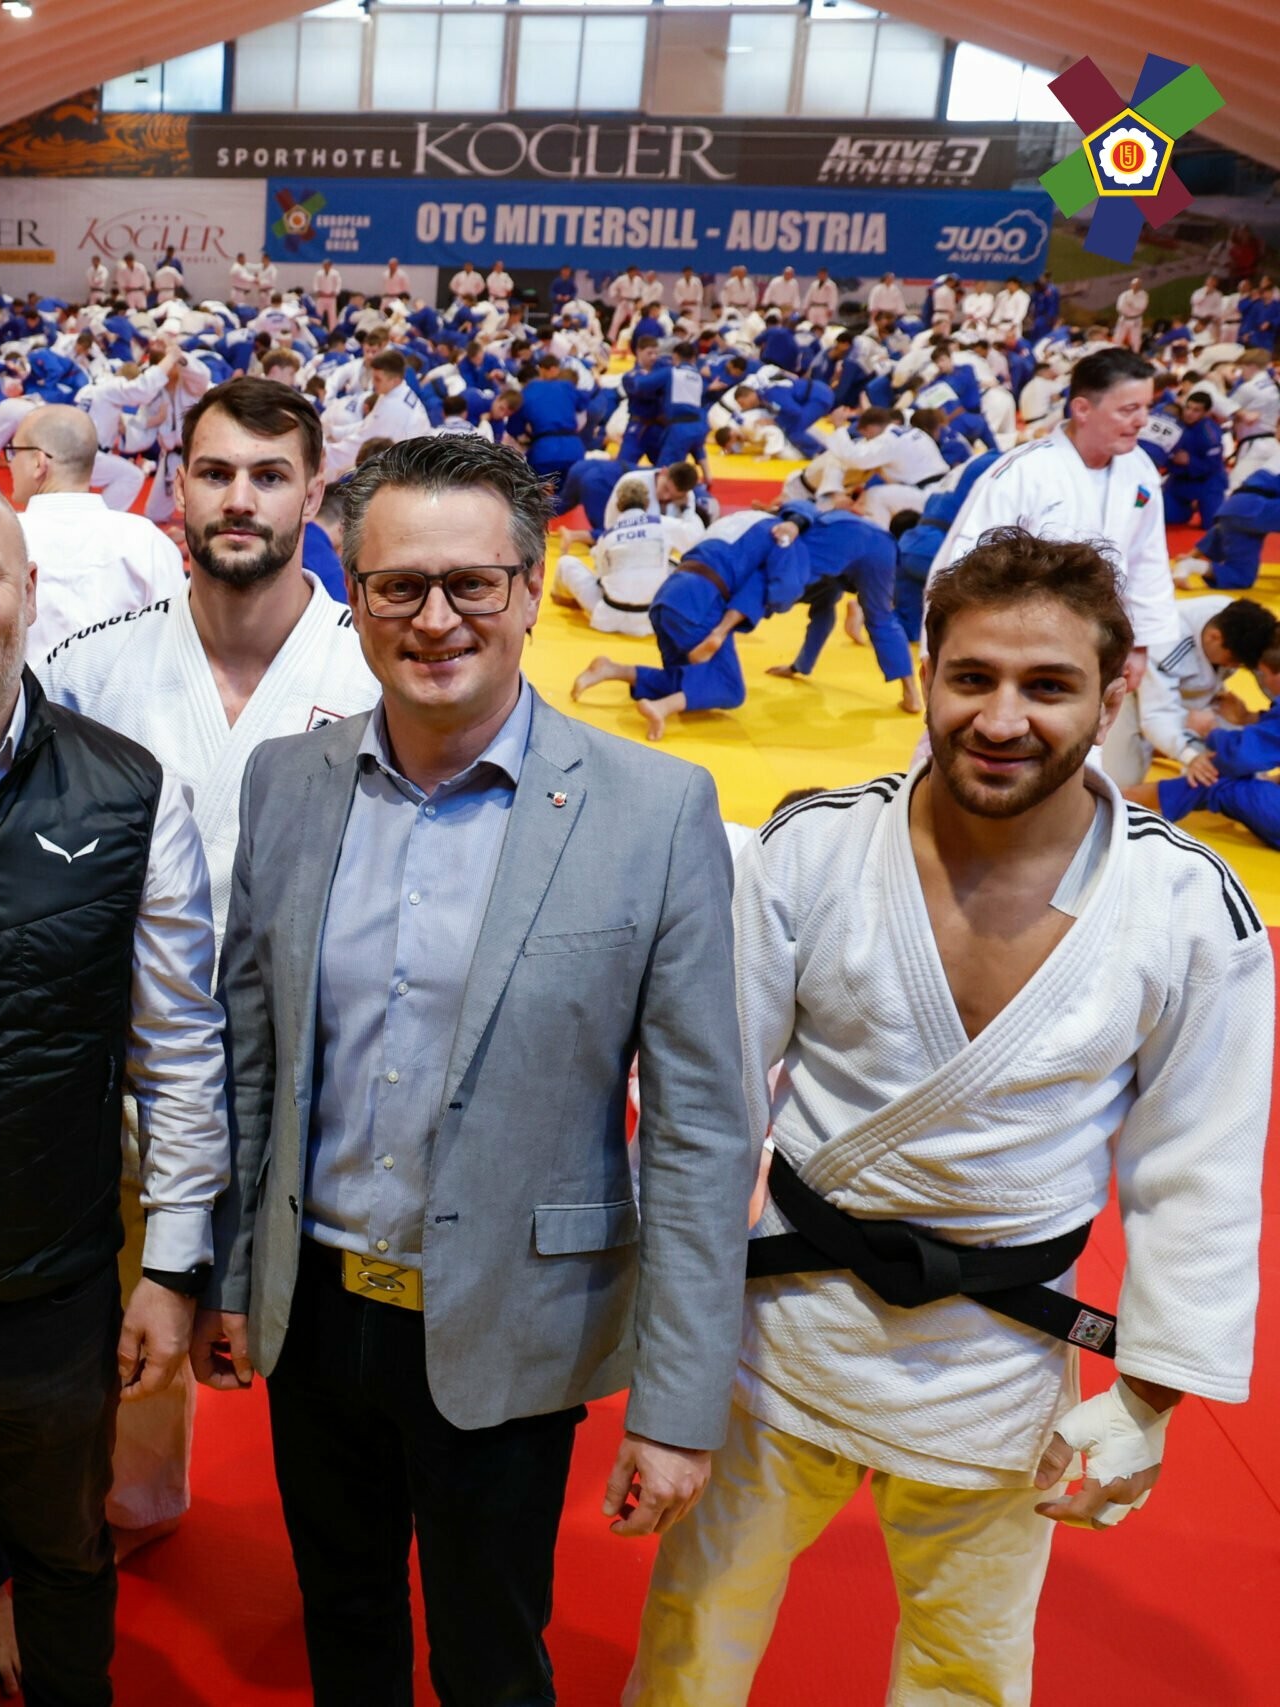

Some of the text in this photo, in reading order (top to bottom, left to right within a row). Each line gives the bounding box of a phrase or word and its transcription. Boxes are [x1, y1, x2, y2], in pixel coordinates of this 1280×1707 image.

[216, 121, 737, 181] SPORTHOTEL KOGLER
[827, 136, 944, 160] ACTIVE
[819, 159, 934, 175] FITNESS
[78, 217, 233, 259] KOGLER
[416, 201, 487, 245] OTC
[493, 204, 699, 249] MITTERSILL
[725, 208, 888, 254] AUSTRIA
[935, 226, 1028, 251] JUDO
[947, 251, 1022, 263] AUSTRIA
